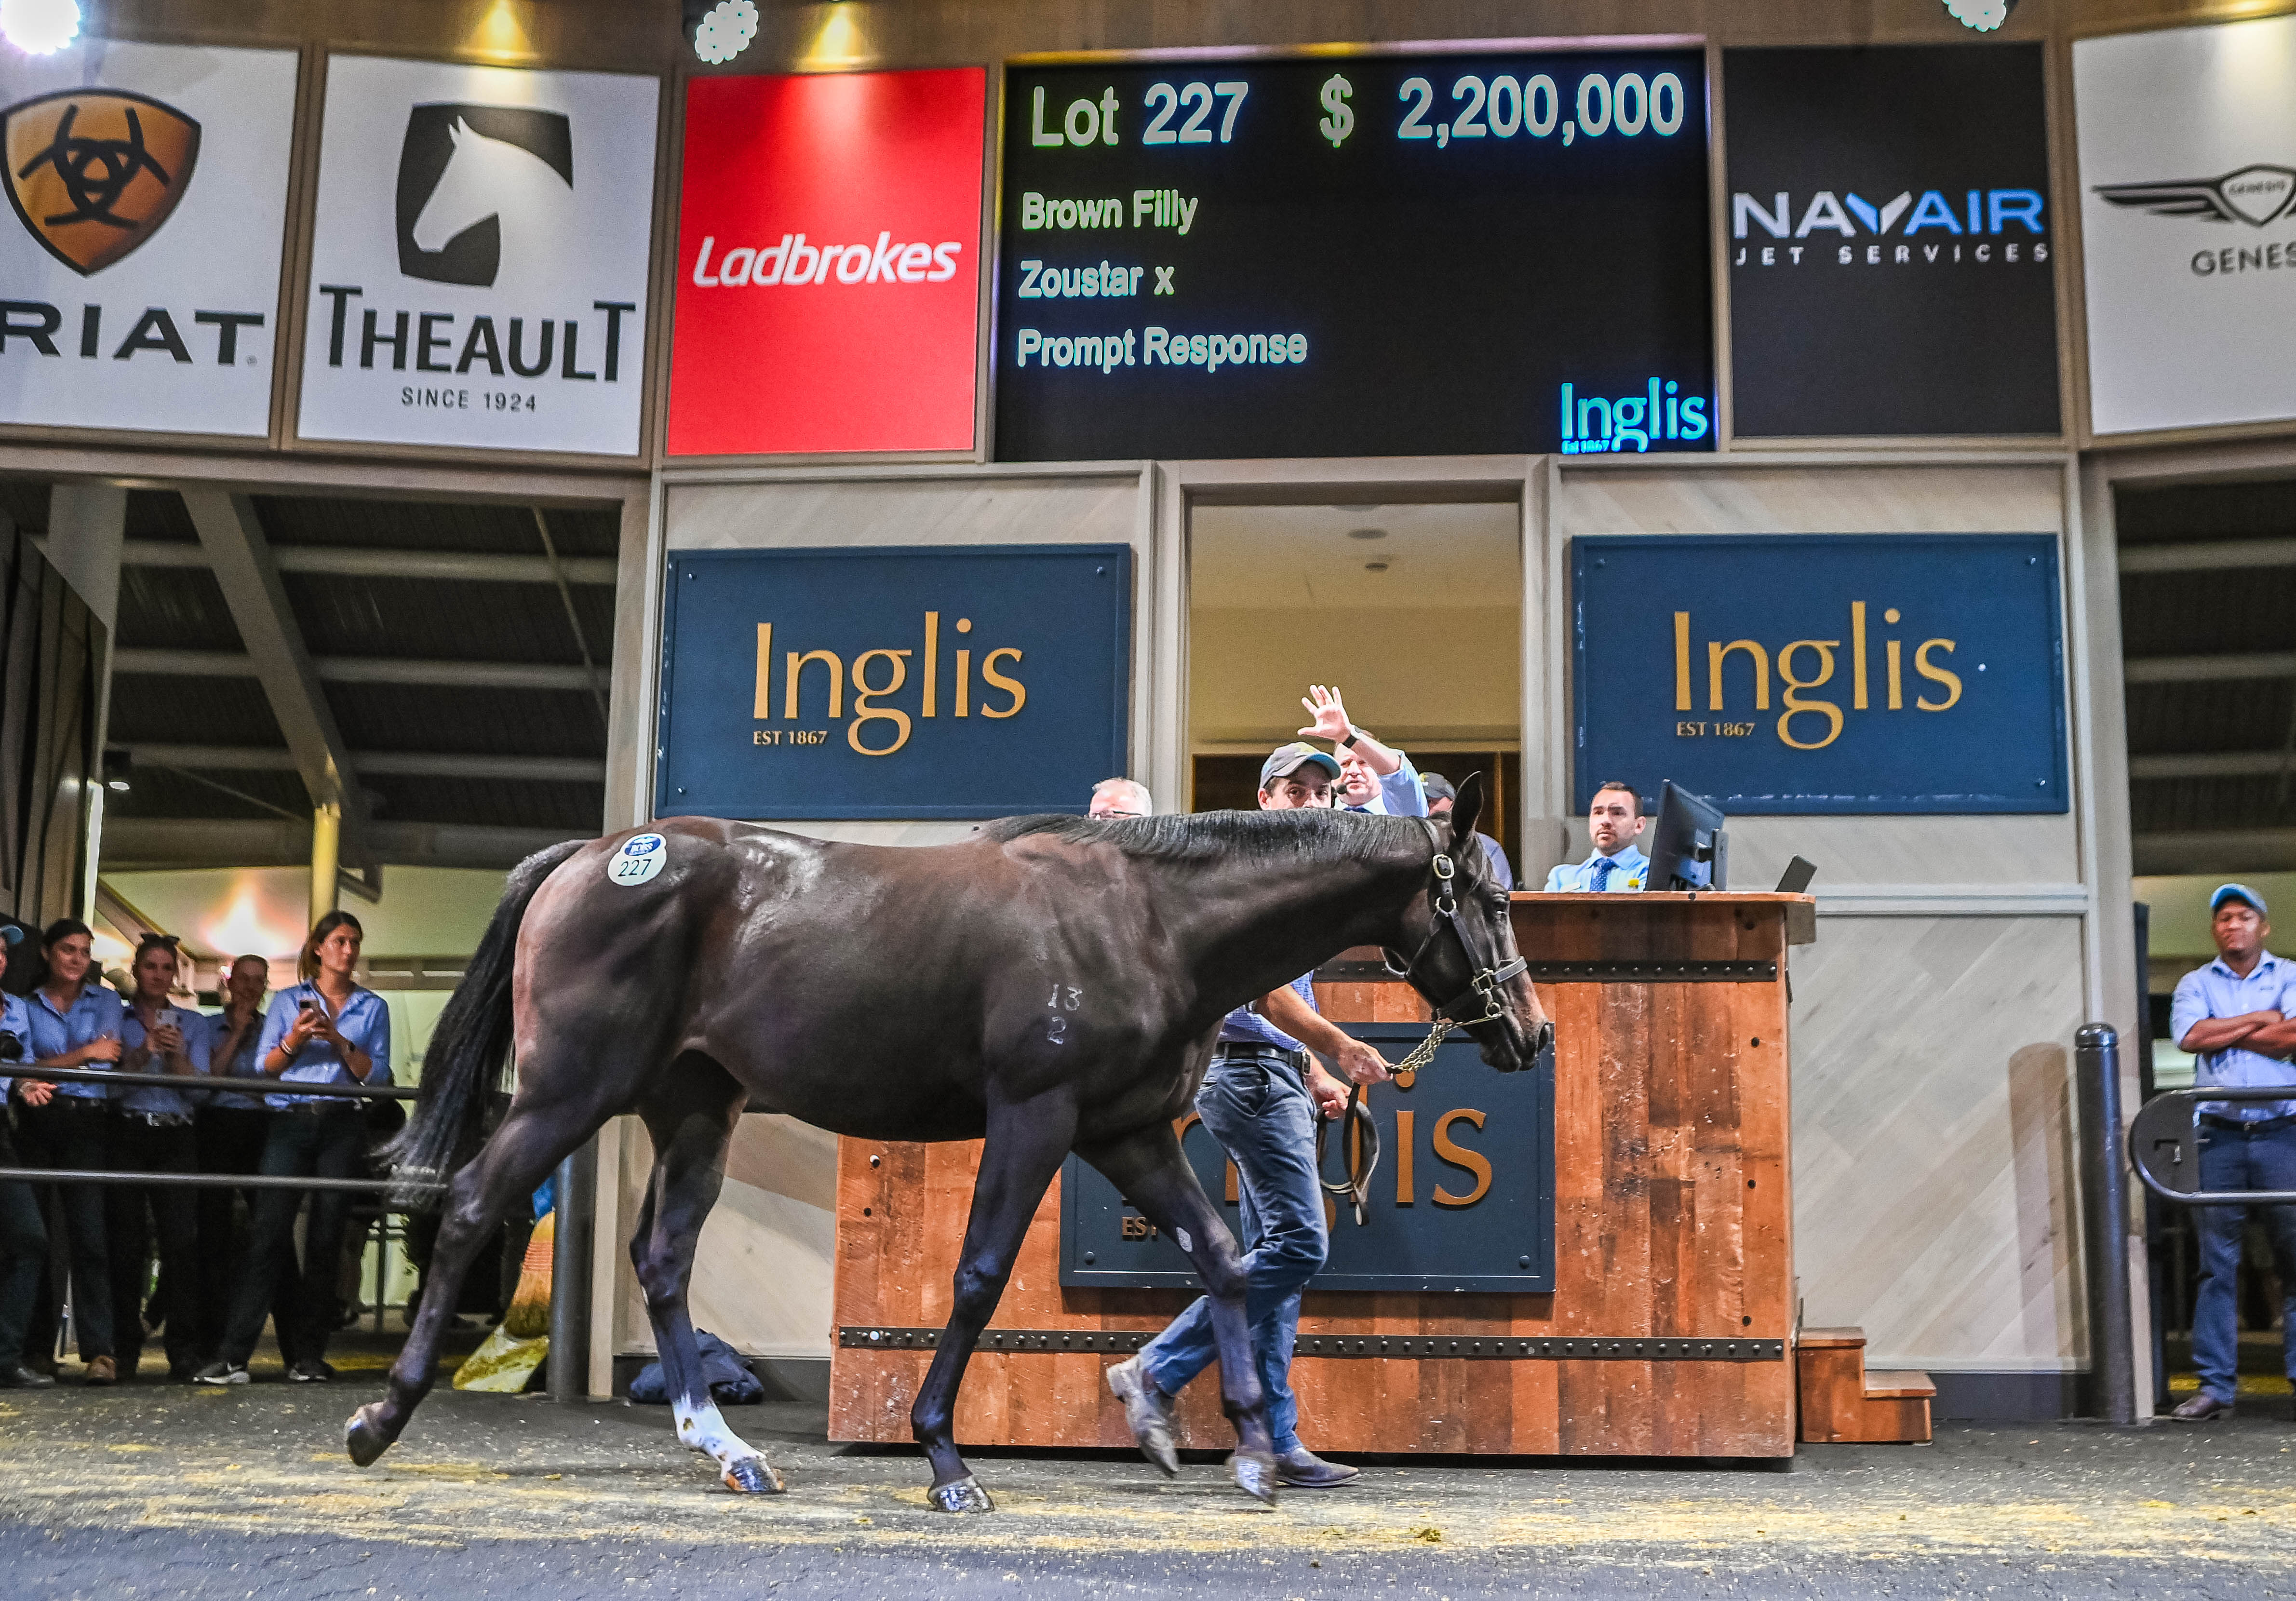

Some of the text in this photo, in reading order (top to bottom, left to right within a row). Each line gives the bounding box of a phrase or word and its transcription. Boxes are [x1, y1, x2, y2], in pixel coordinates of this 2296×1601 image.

[1032, 72, 1684, 148] Lot 227 $ 2,200,000
[1022, 189, 1198, 236] Brown Filly
[1733, 189, 2043, 239] NAVAIR
[693, 230, 962, 287] Ladbrokes
[1018, 259, 1175, 298] Zoustar x
[1735, 242, 2048, 266] JET SERVICES
[319, 283, 636, 382] THEAULT
[1017, 326, 1308, 375] Prompt Response
[401, 387, 537, 413] SINCE 1924
[1561, 377, 1708, 453] Inglis
[753, 611, 1026, 756] Inglis
[1674, 601, 1962, 750] Inglis
[753, 730, 828, 745] EST 1867
[1677, 722, 1755, 738] EST 1867
[618, 859, 652, 877] 227
